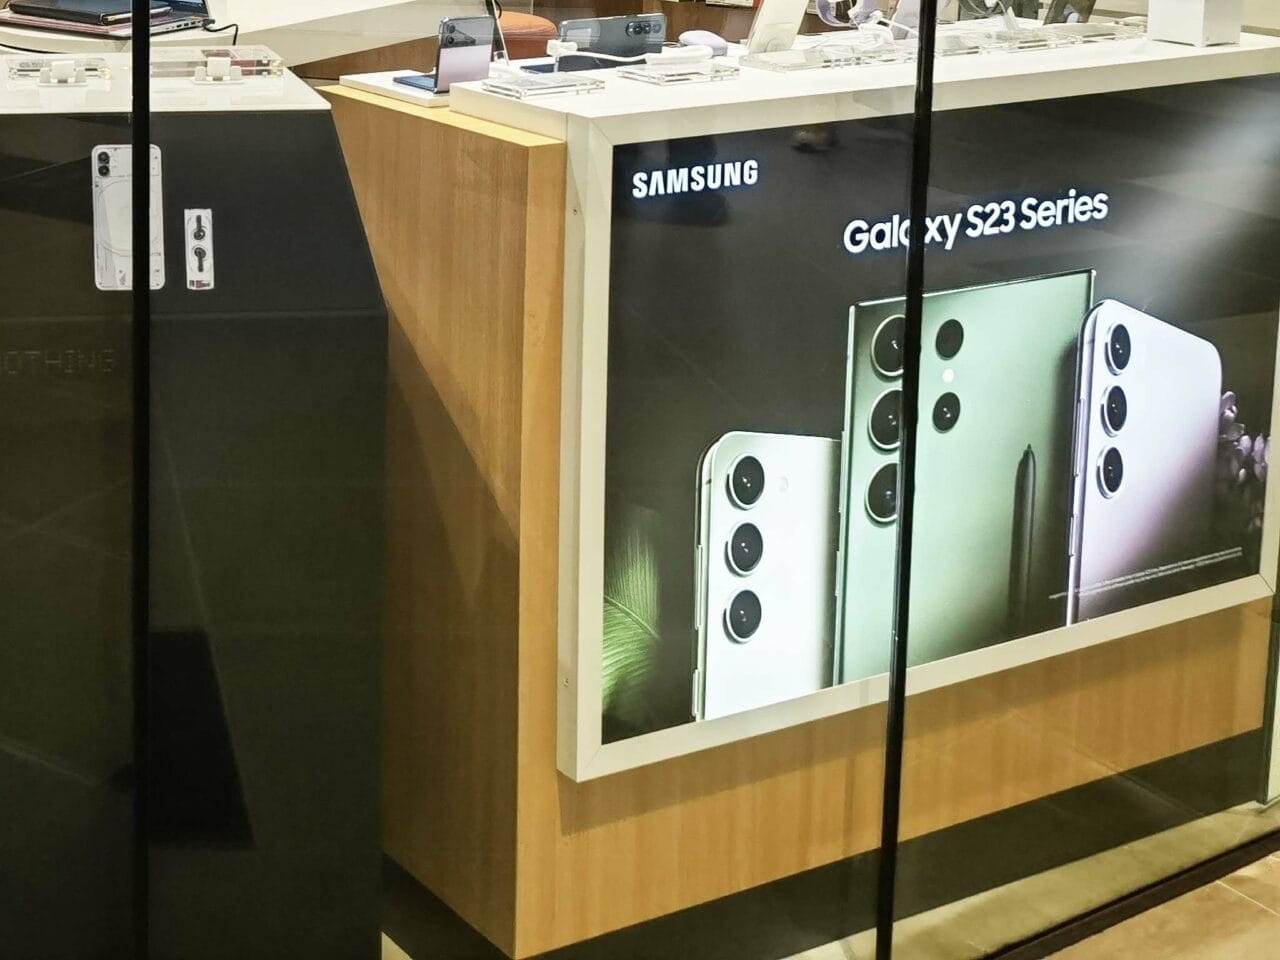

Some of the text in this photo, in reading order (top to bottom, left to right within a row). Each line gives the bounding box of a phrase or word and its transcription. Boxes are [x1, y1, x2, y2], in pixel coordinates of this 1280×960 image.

[632, 159, 759, 199] SAMSUNG
[965, 200, 1016, 238] S23
[1019, 189, 1109, 229] Series
